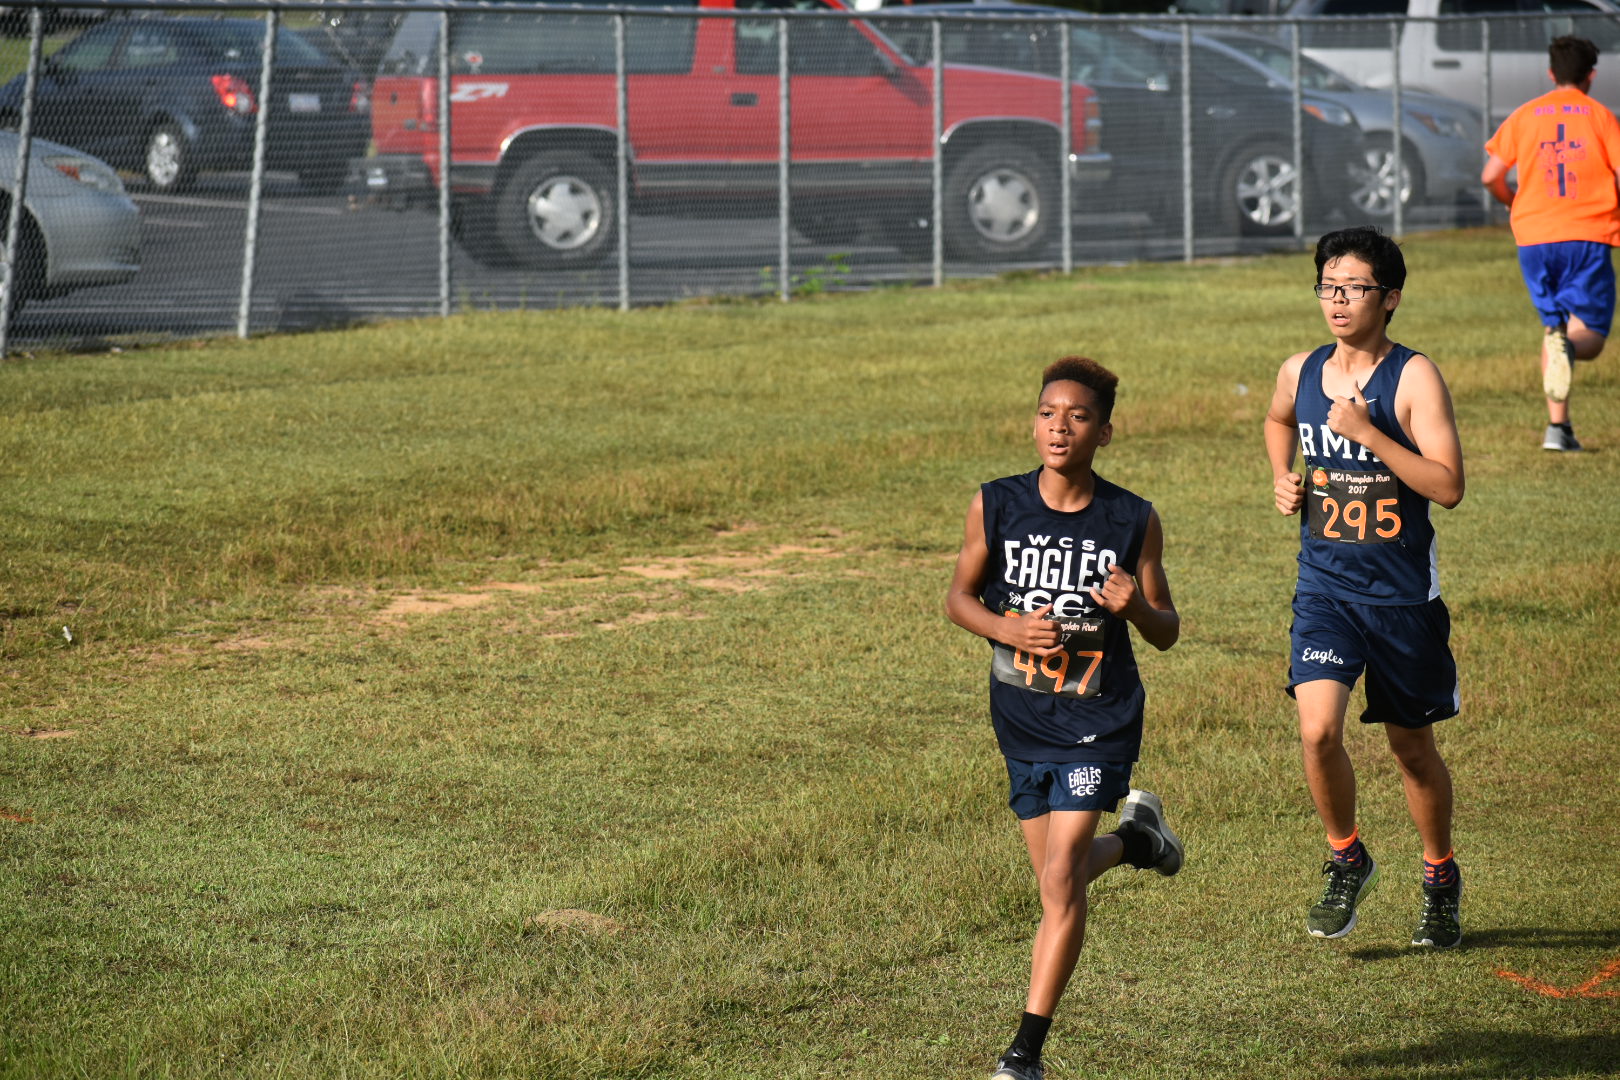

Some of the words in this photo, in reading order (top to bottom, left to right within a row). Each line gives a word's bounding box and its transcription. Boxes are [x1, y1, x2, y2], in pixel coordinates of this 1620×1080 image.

[1330, 471, 1345, 481] WCA
[1345, 474, 1374, 484] Pumpkin
[1375, 474, 1390, 482] Run
[1348, 485, 1368, 495] 2017
[1322, 497, 1402, 540] 295
[1028, 534, 1096, 551] WCS
[1081, 621, 1098, 632] Run
[1302, 647, 1344, 665] Eagles
[1013, 647, 1104, 695] 497
[1068, 769, 1101, 788] EAGLES
